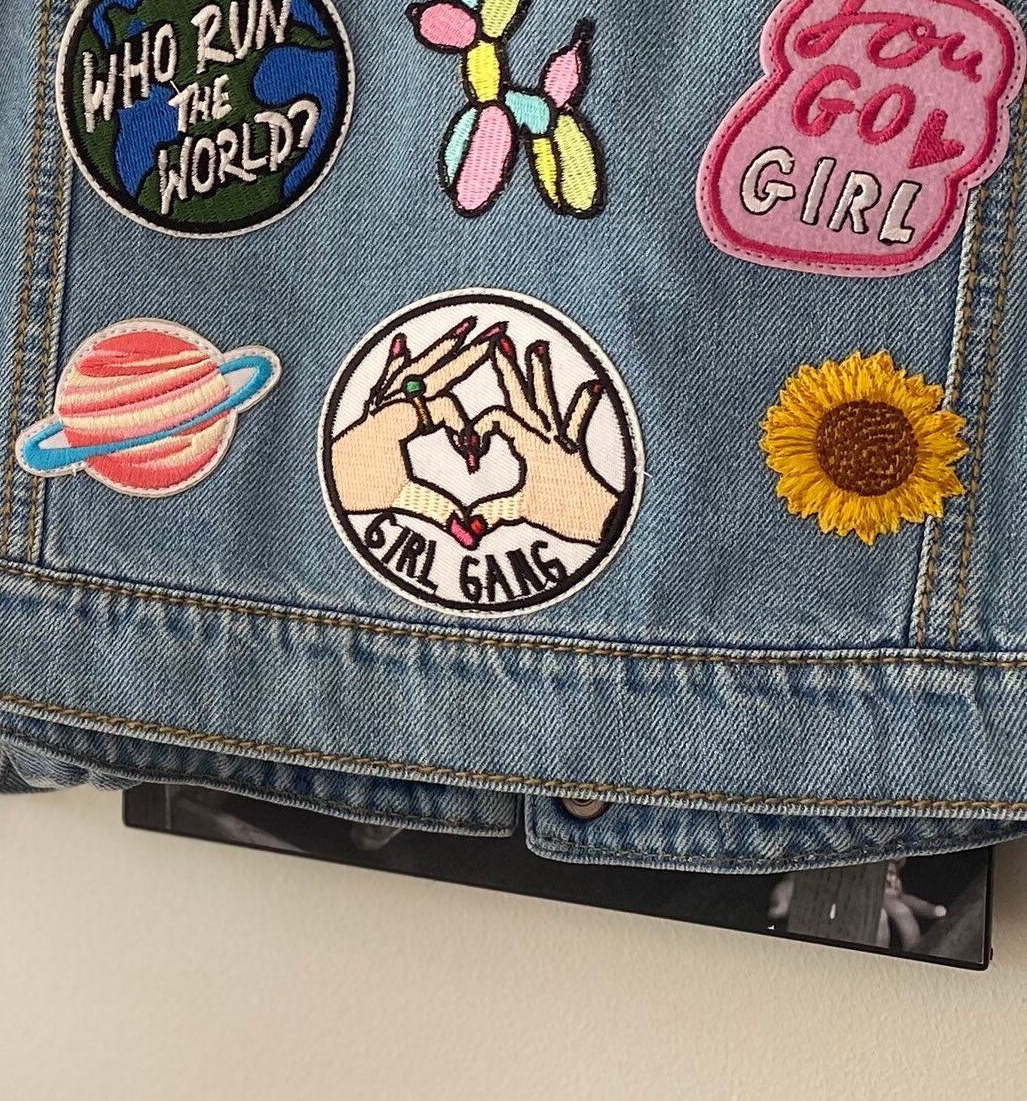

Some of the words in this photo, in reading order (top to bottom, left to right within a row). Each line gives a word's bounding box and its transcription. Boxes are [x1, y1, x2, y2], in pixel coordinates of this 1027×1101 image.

[83, 23, 178, 134] WHO
[168, 74, 233, 133] THE
[159, 100, 320, 215] WORLD?
[740, 146, 923, 245] GIRL
[364, 511, 439, 591] GIRL
[459, 540, 571, 602] GANG
